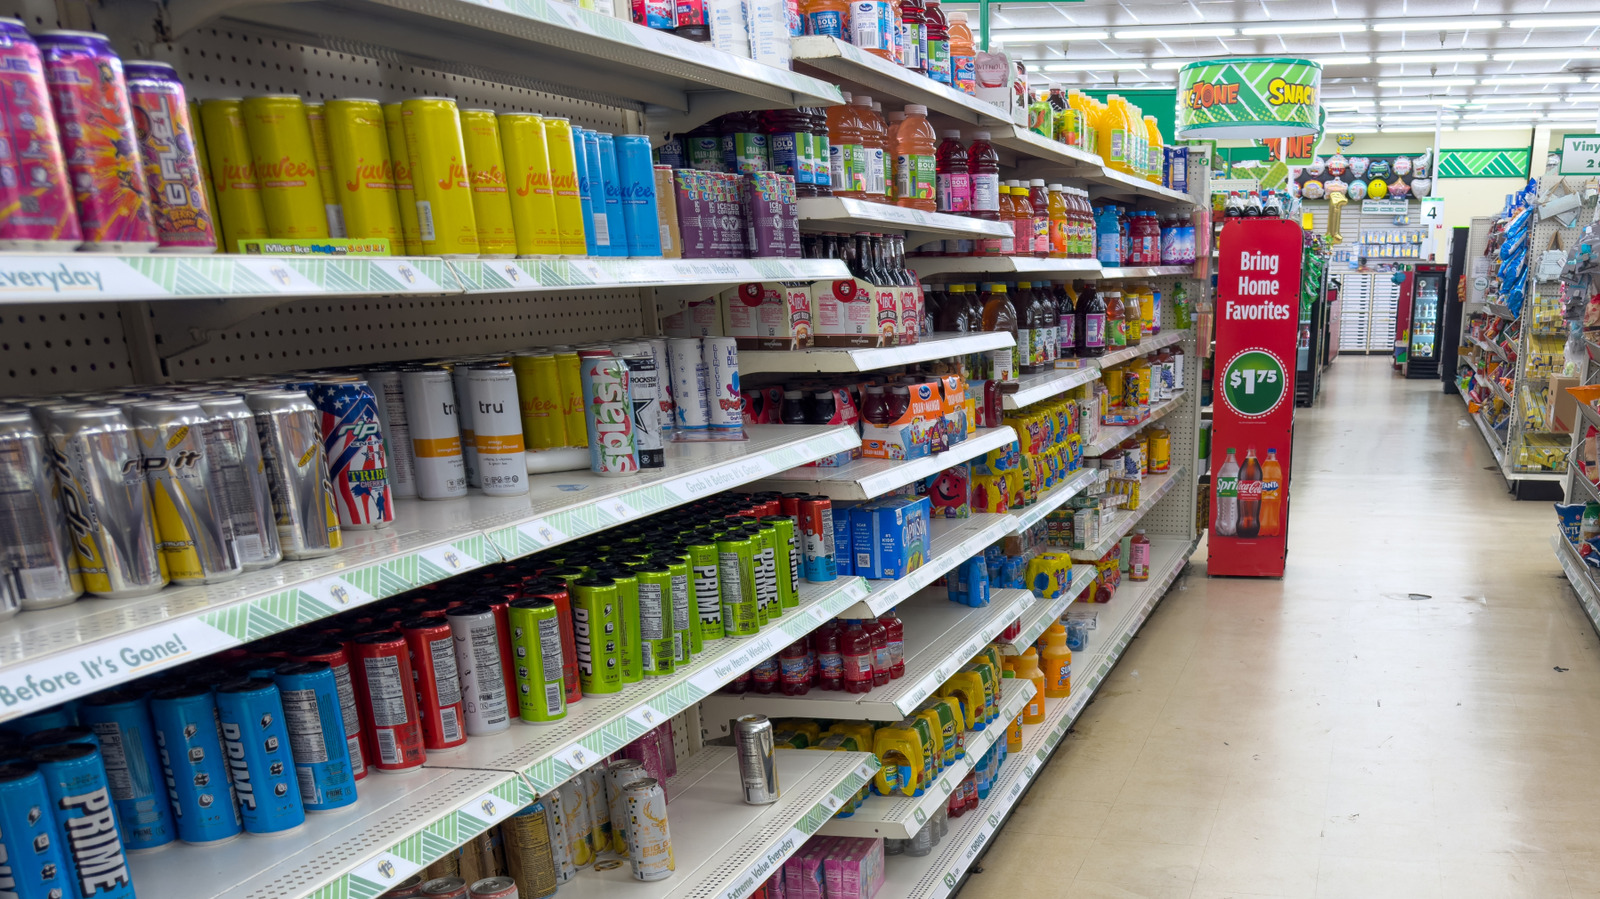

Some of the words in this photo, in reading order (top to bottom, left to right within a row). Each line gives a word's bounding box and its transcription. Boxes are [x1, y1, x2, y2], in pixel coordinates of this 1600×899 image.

[1192, 80, 1241, 110] ZONE
[1268, 77, 1318, 106] SNACK
[1572, 141, 1600, 154] Viny
[1426, 206, 1438, 220] 4
[1240, 250, 1280, 275] Bring
[0, 264, 104, 293] veryday
[1238, 276, 1280, 296] Home
[1225, 300, 1290, 321] Favorites
[479, 400, 504, 414] tru
[592, 361, 632, 473] splash
[337, 420, 379, 441] rip
[174, 450, 202, 468] it
[711, 470, 734, 489] Before
[1217, 478, 1238, 493] Spri
[762, 547, 779, 605] PRIME
[693, 564, 721, 625] PRIME
[574, 607, 592, 677] PRIME
[0, 668, 82, 708] Before
[81, 655, 119, 681] It's
[119, 632, 189, 668] Gone!
[713, 663, 732, 679] New
[731, 652, 750, 669] Items
[748, 638, 772, 660] Weekly!
[221, 722, 258, 812] PRIME
[58, 786, 129, 899] PRIME
[727, 871, 755, 899] Extreme
[751, 854, 771, 882] Value
[767, 837, 796, 867] Everyday
